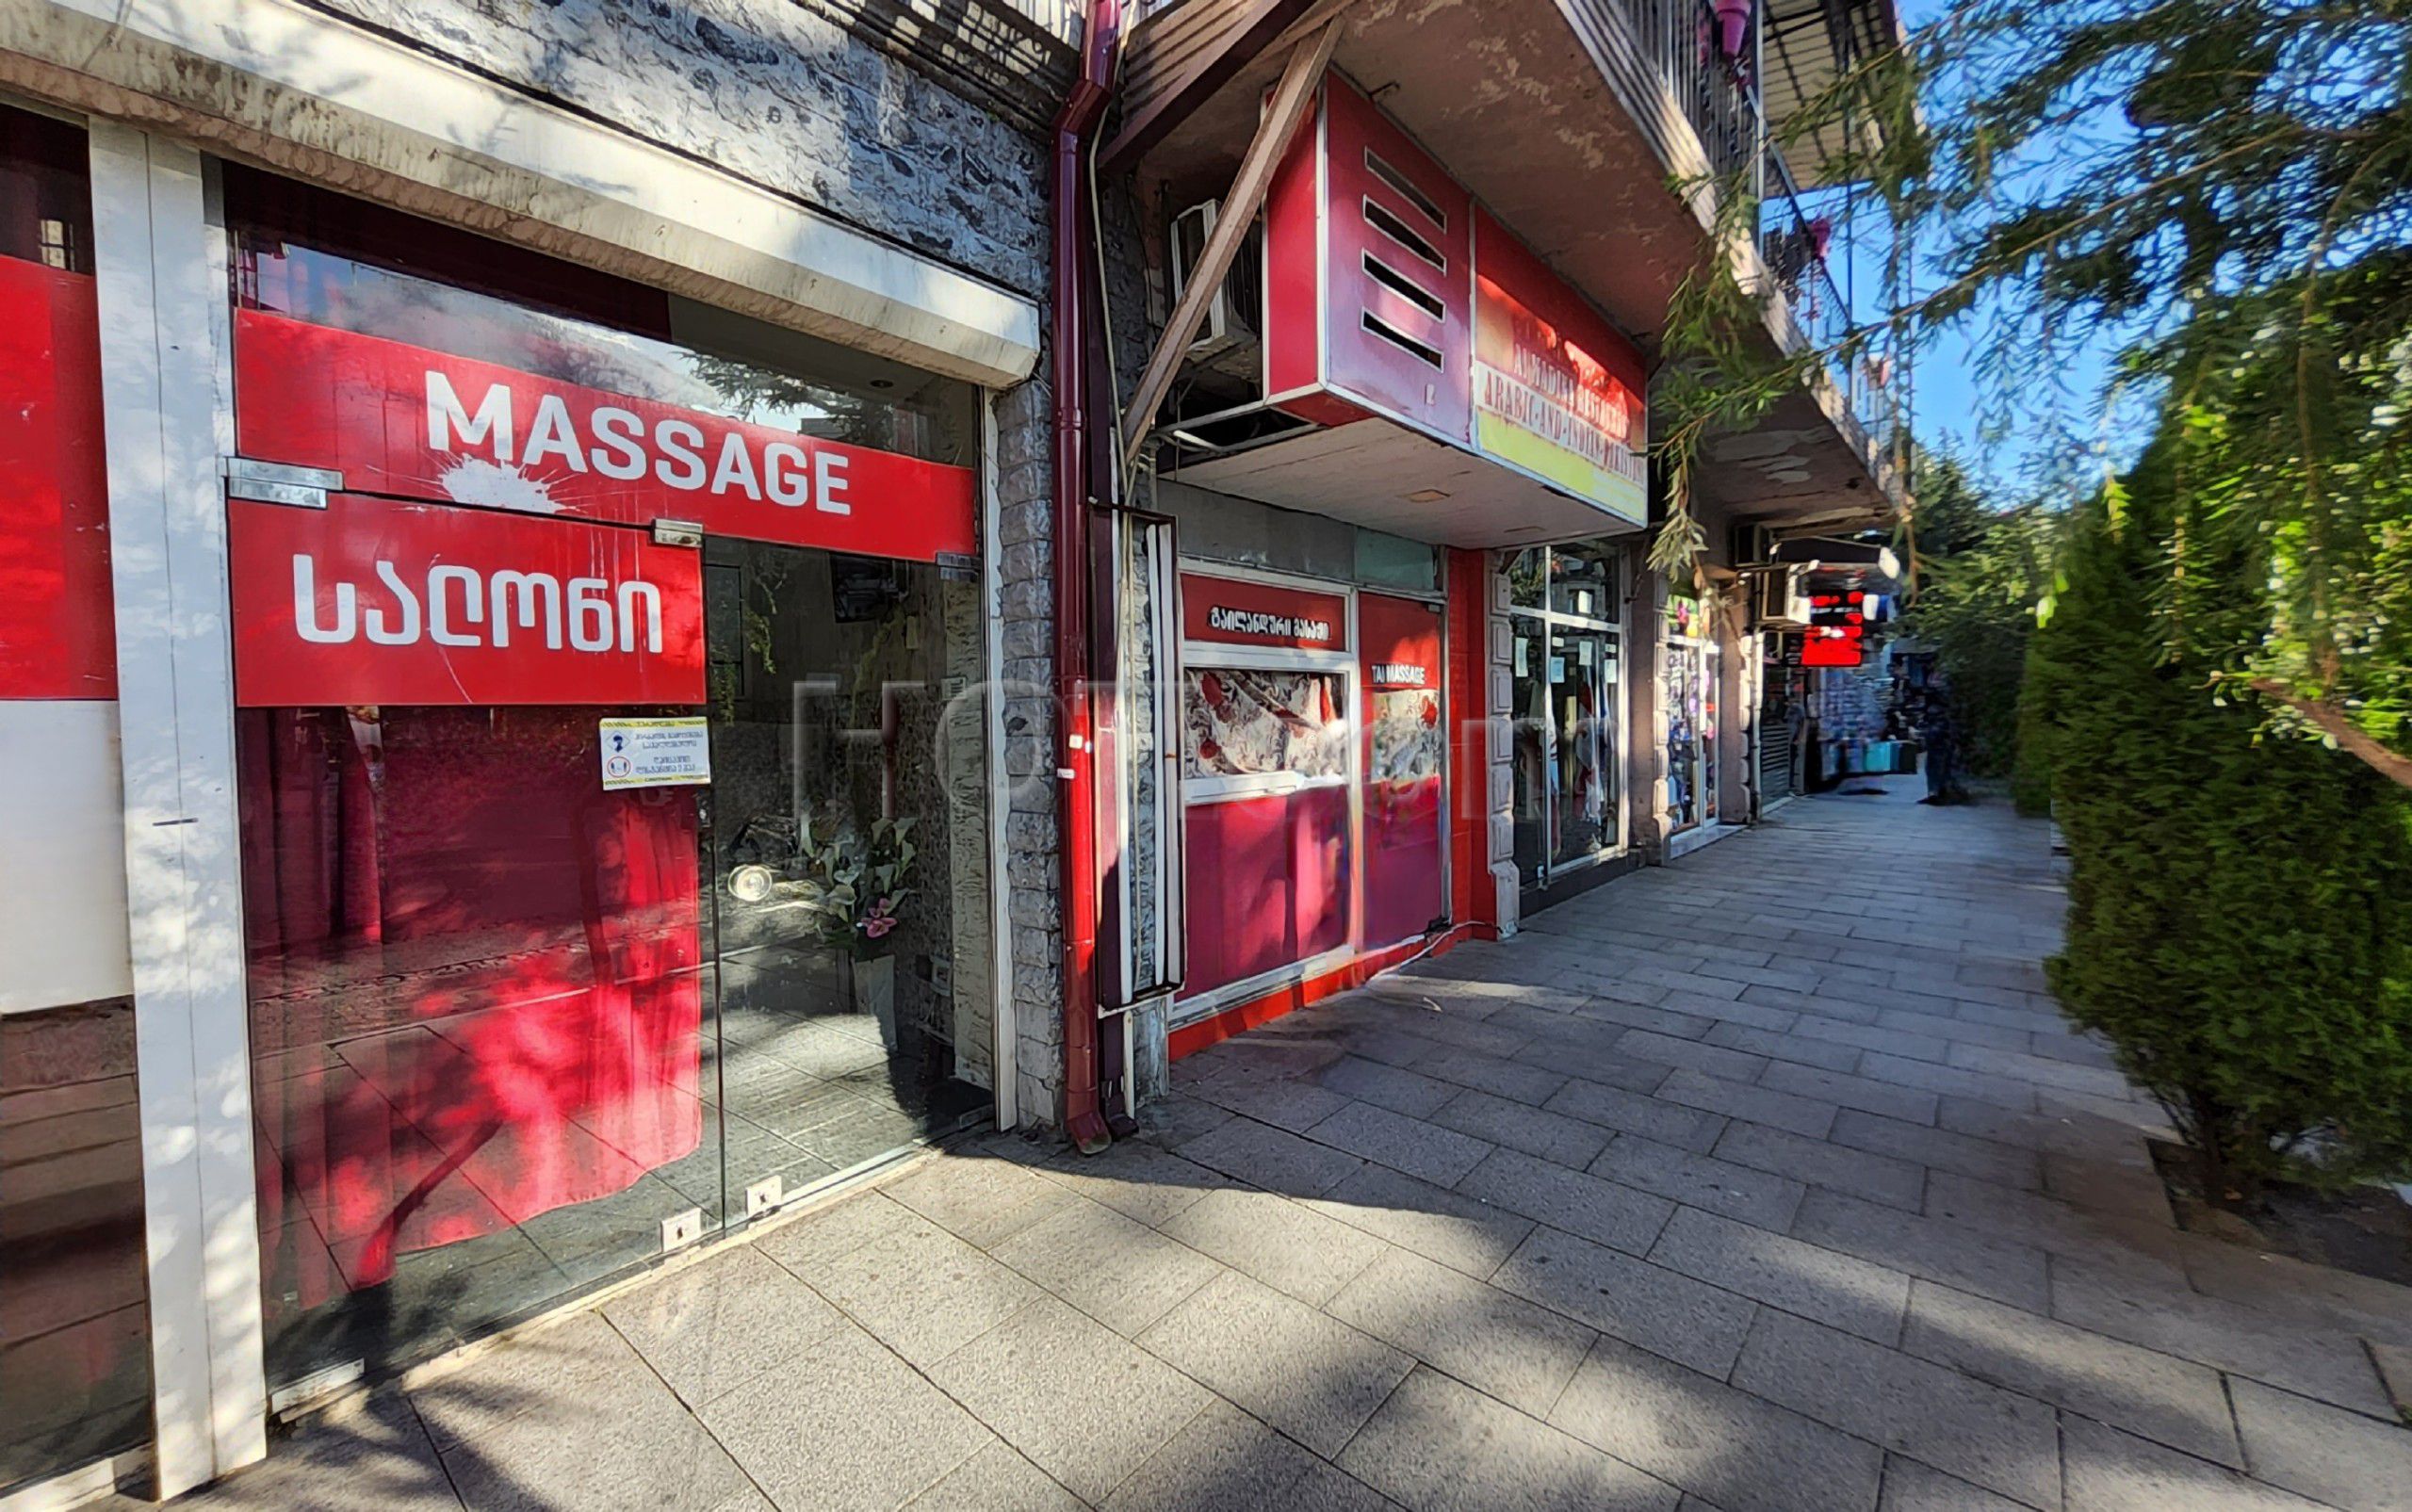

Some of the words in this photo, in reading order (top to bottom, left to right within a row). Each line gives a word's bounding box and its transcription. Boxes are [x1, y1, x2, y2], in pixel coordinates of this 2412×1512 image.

[425, 370, 851, 515] MASSAGE
[1484, 371, 1535, 428] ARABIC
[1539, 401, 1562, 441] AND
[293, 554, 662, 654] სალონი
[1371, 664, 1385, 684] TAI
[1386, 664, 1426, 685] MASSAGE
